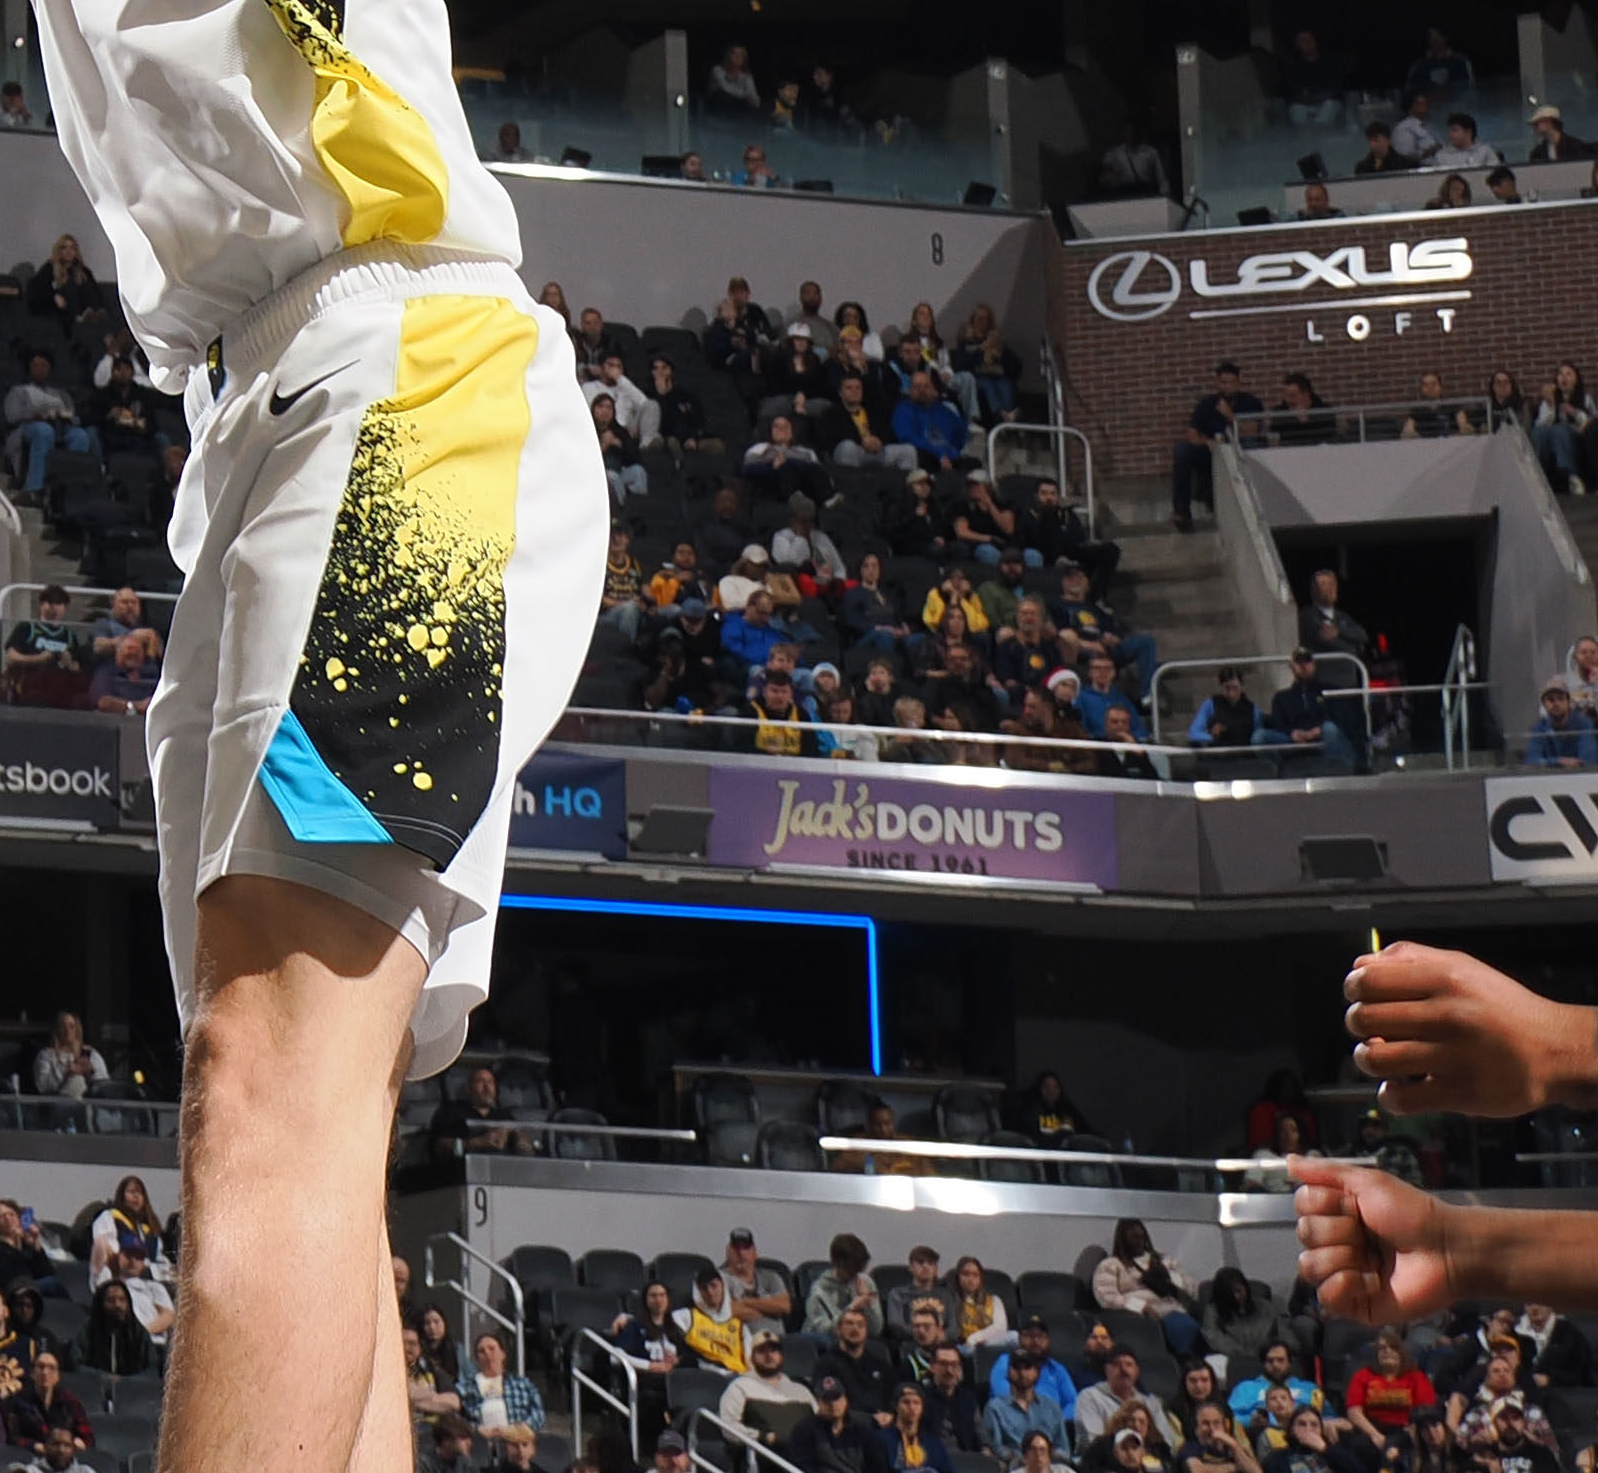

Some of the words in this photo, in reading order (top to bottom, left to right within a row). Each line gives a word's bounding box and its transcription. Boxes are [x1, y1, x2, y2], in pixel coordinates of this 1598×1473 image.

[931, 232, 943, 266] 8
[1189, 236, 1473, 297] LEXUS
[544, 785, 603, 819] HQ
[763, 779, 877, 856] Jack's
[876, 802, 1064, 853] DONUTS
[846, 847, 921, 872] SINCE
[930, 853, 991, 876] 1961
[474, 1187, 488, 1227] 9
